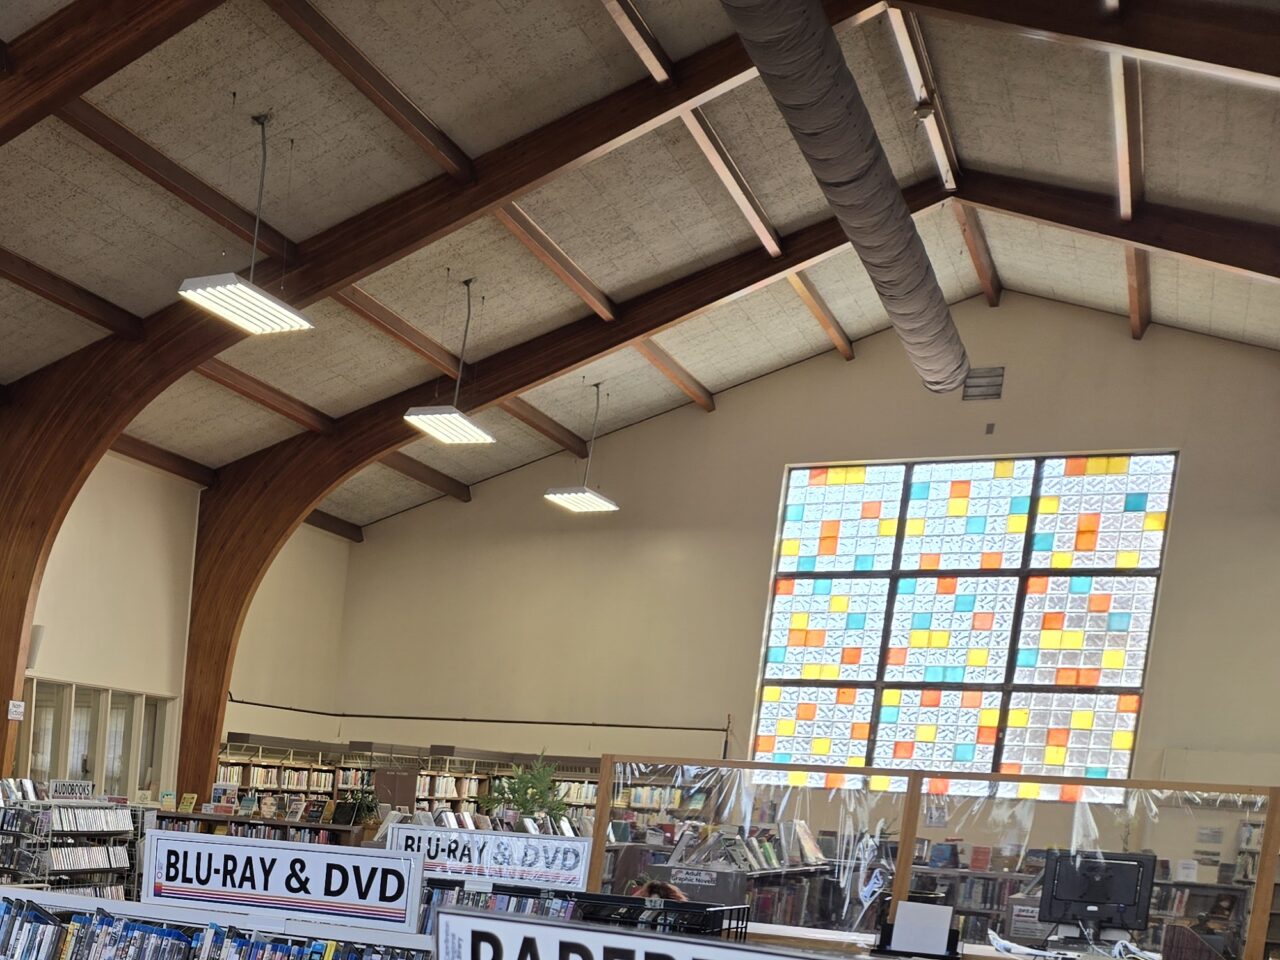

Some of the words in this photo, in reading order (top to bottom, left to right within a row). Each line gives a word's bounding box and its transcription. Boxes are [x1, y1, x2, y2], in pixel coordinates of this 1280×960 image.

[53, 782, 91, 796] AUDIOBOOKS
[493, 841, 512, 866] &
[521, 843, 581, 871] DVD
[165, 848, 277, 891] BLU-RAY
[285, 858, 311, 895] &
[323, 862, 406, 903] DVD
